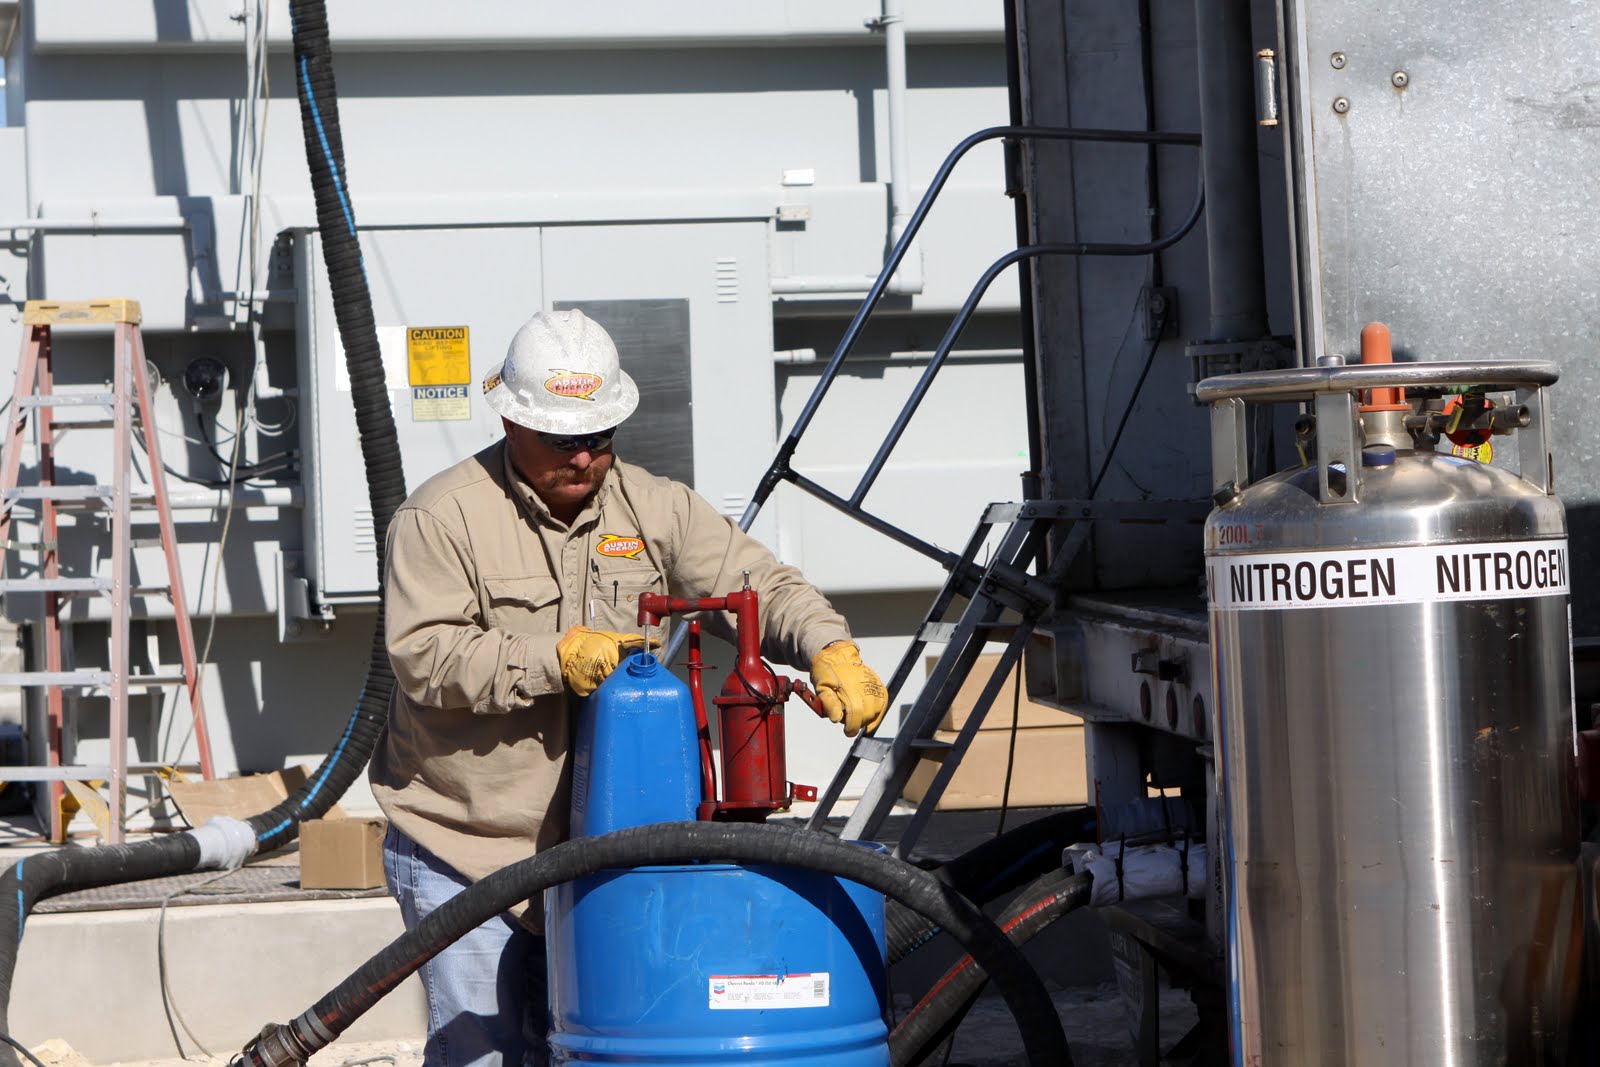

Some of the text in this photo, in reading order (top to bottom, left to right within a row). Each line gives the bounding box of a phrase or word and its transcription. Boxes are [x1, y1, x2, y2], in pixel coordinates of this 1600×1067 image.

[412, 329, 464, 339] CAUTION
[416, 387, 465, 399] NOTICE
[1230, 557, 1396, 603] NITROGEN
[1436, 548, 1566, 594] NITROGEN
